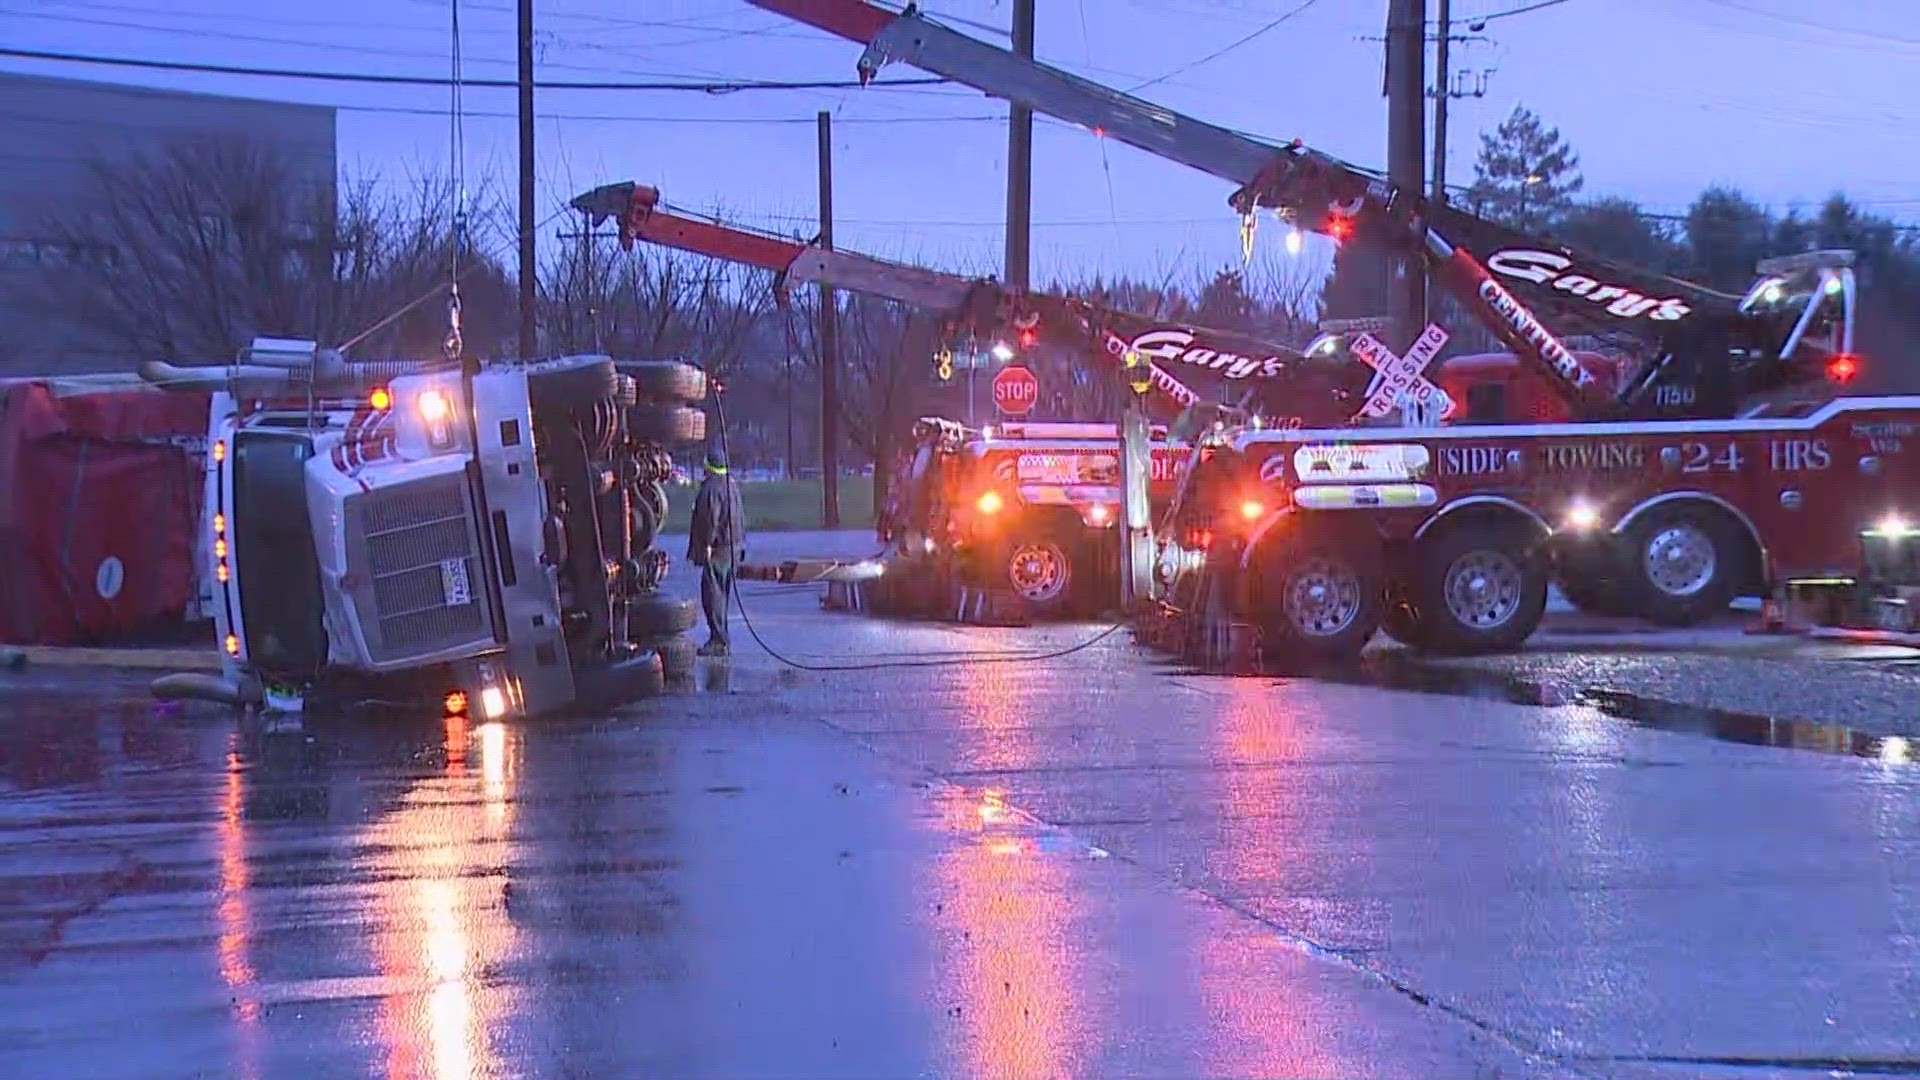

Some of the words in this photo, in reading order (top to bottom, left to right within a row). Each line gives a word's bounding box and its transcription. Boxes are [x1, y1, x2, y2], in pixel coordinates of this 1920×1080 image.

[1488, 246, 1692, 320] Gary's
[1131, 330, 1285, 378] Gary's
[1479, 277, 1595, 388] CENTURY
[996, 381, 1033, 400] STOP
[1107, 334, 1200, 406] CTURY
[1373, 329, 1442, 412] ROSSING
[1544, 444, 1644, 472] TOWING
[1682, 441, 1744, 472] 24
[1770, 439, 1831, 471] HRS
